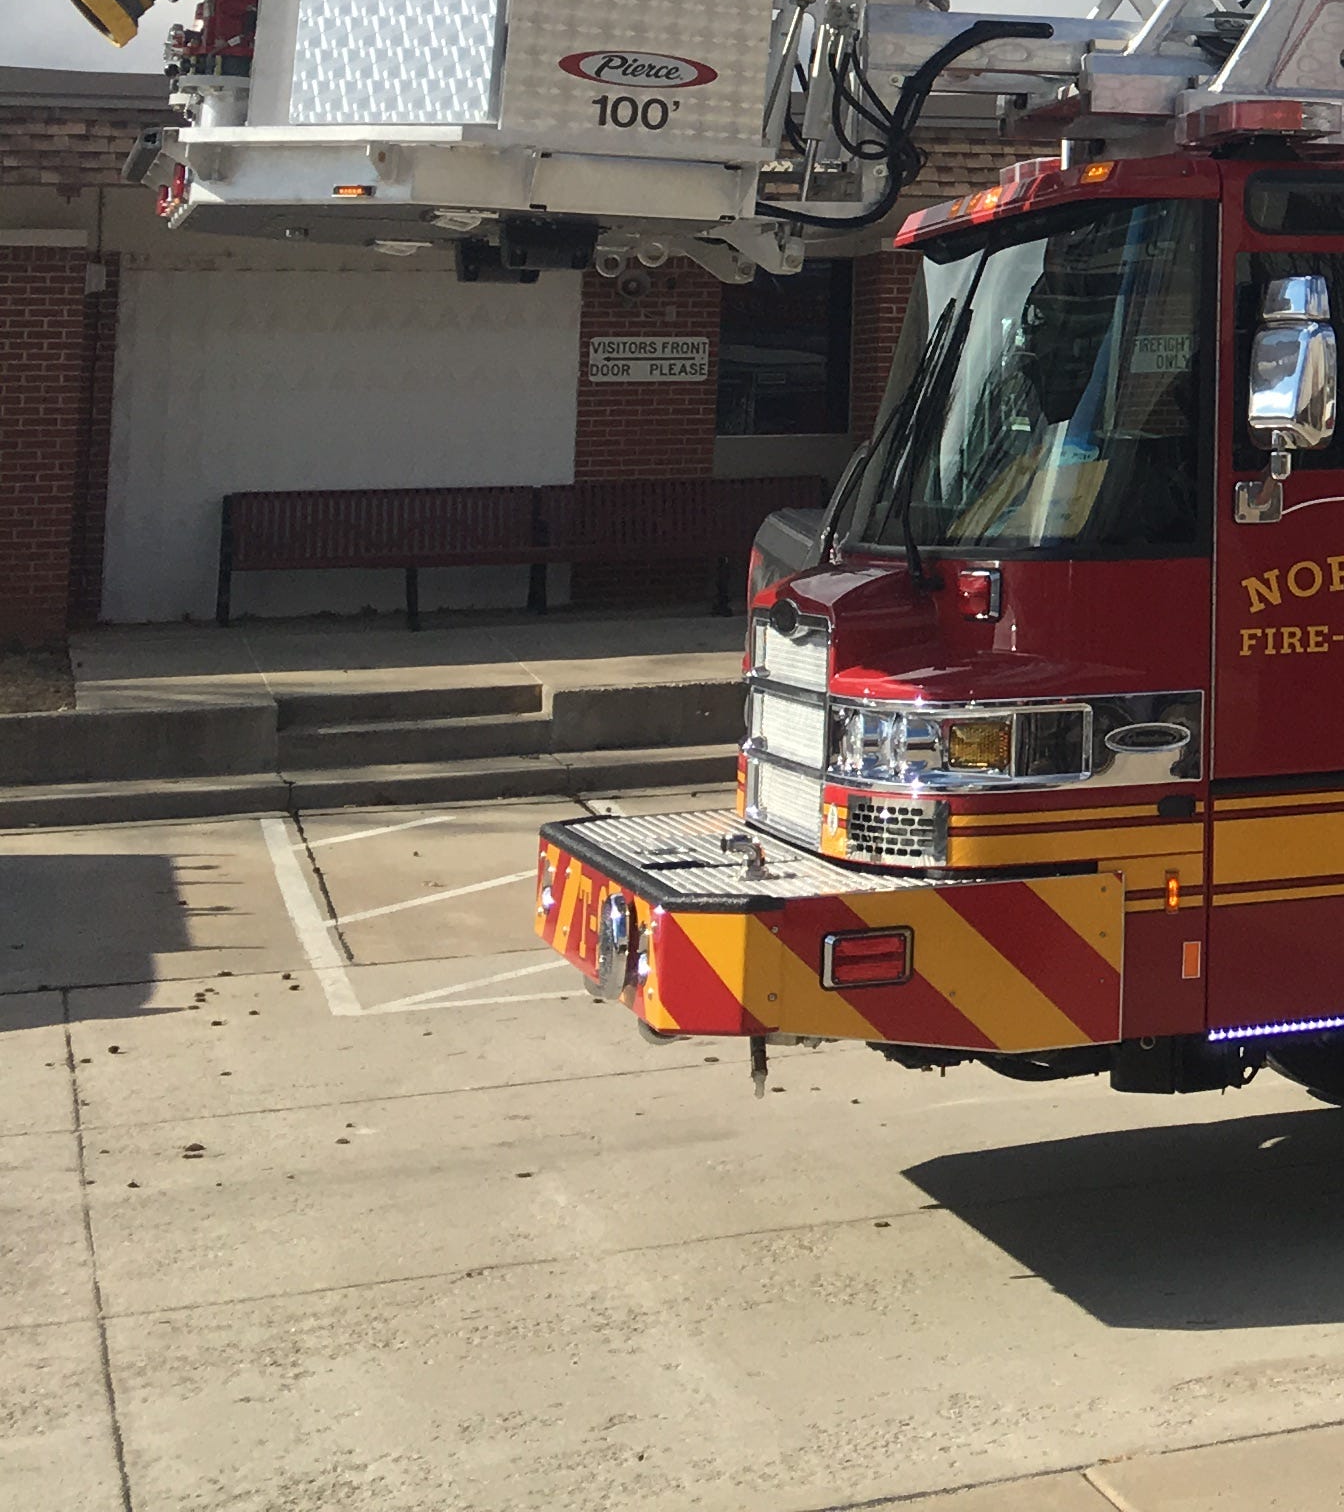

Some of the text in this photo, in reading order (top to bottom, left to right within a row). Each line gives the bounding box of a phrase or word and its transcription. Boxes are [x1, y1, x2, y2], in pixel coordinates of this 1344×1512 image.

[594, 54, 682, 81] Pierce
[592, 95, 681, 131] 100'
[591, 341, 708, 354] VISITORS FRONT
[590, 363, 706, 376] DOOR PLEASE
[579, 875, 607, 971] T-
